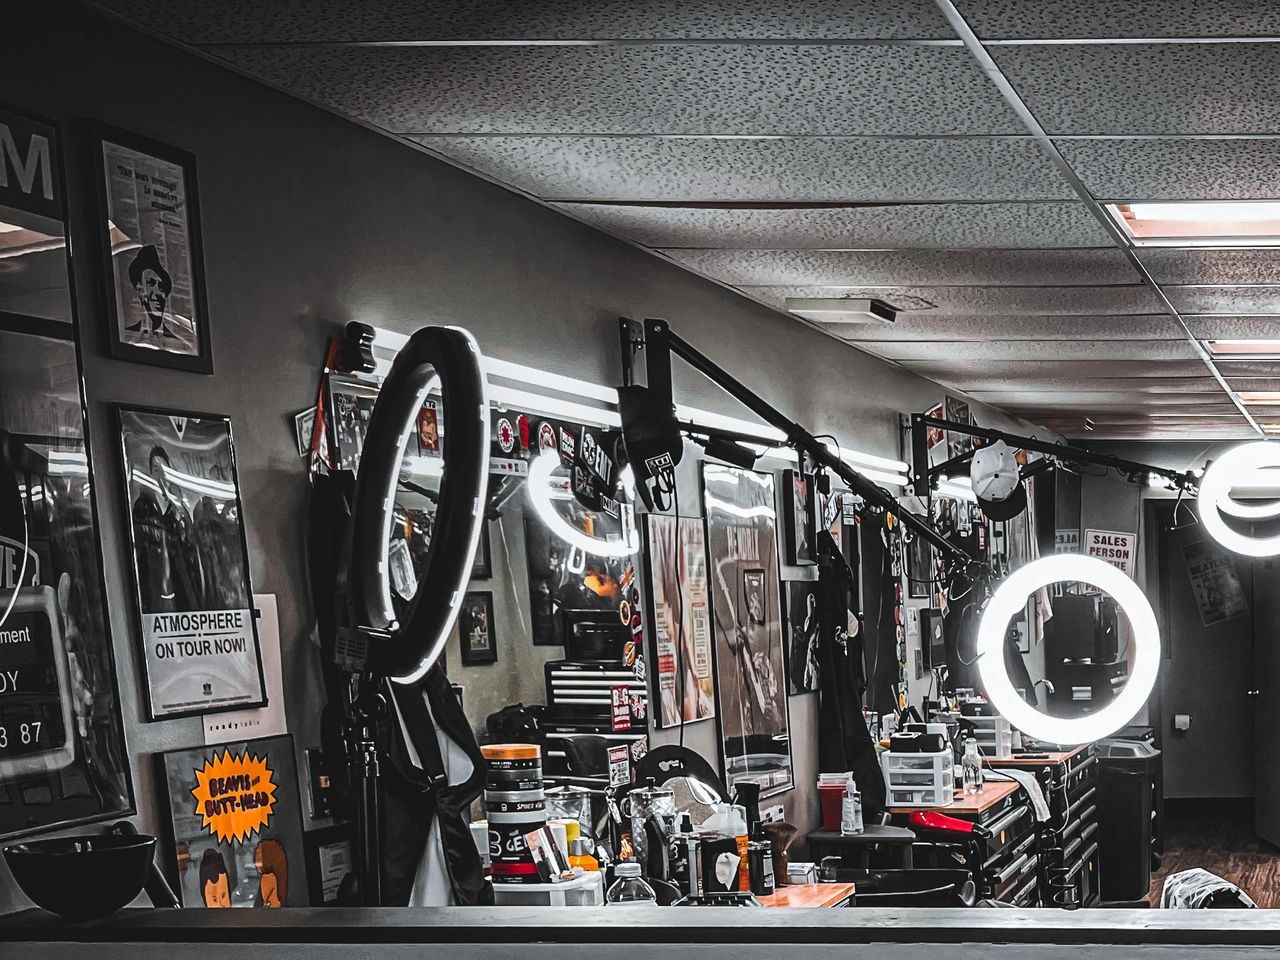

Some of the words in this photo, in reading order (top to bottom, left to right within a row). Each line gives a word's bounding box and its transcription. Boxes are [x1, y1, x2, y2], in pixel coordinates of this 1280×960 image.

[1093, 534, 1128, 547] SALES
[1089, 546, 1130, 560] PERSON
[153, 612, 243, 633] ATMOSPHERE
[155, 643, 174, 659] ON
[176, 640, 212, 657] TOUR
[215, 637, 247, 655] NOW!
[20, 721, 42, 745] 87
[209, 773, 251, 798] BEAVIS
[204, 791, 270, 818] BUTT-HEAD
